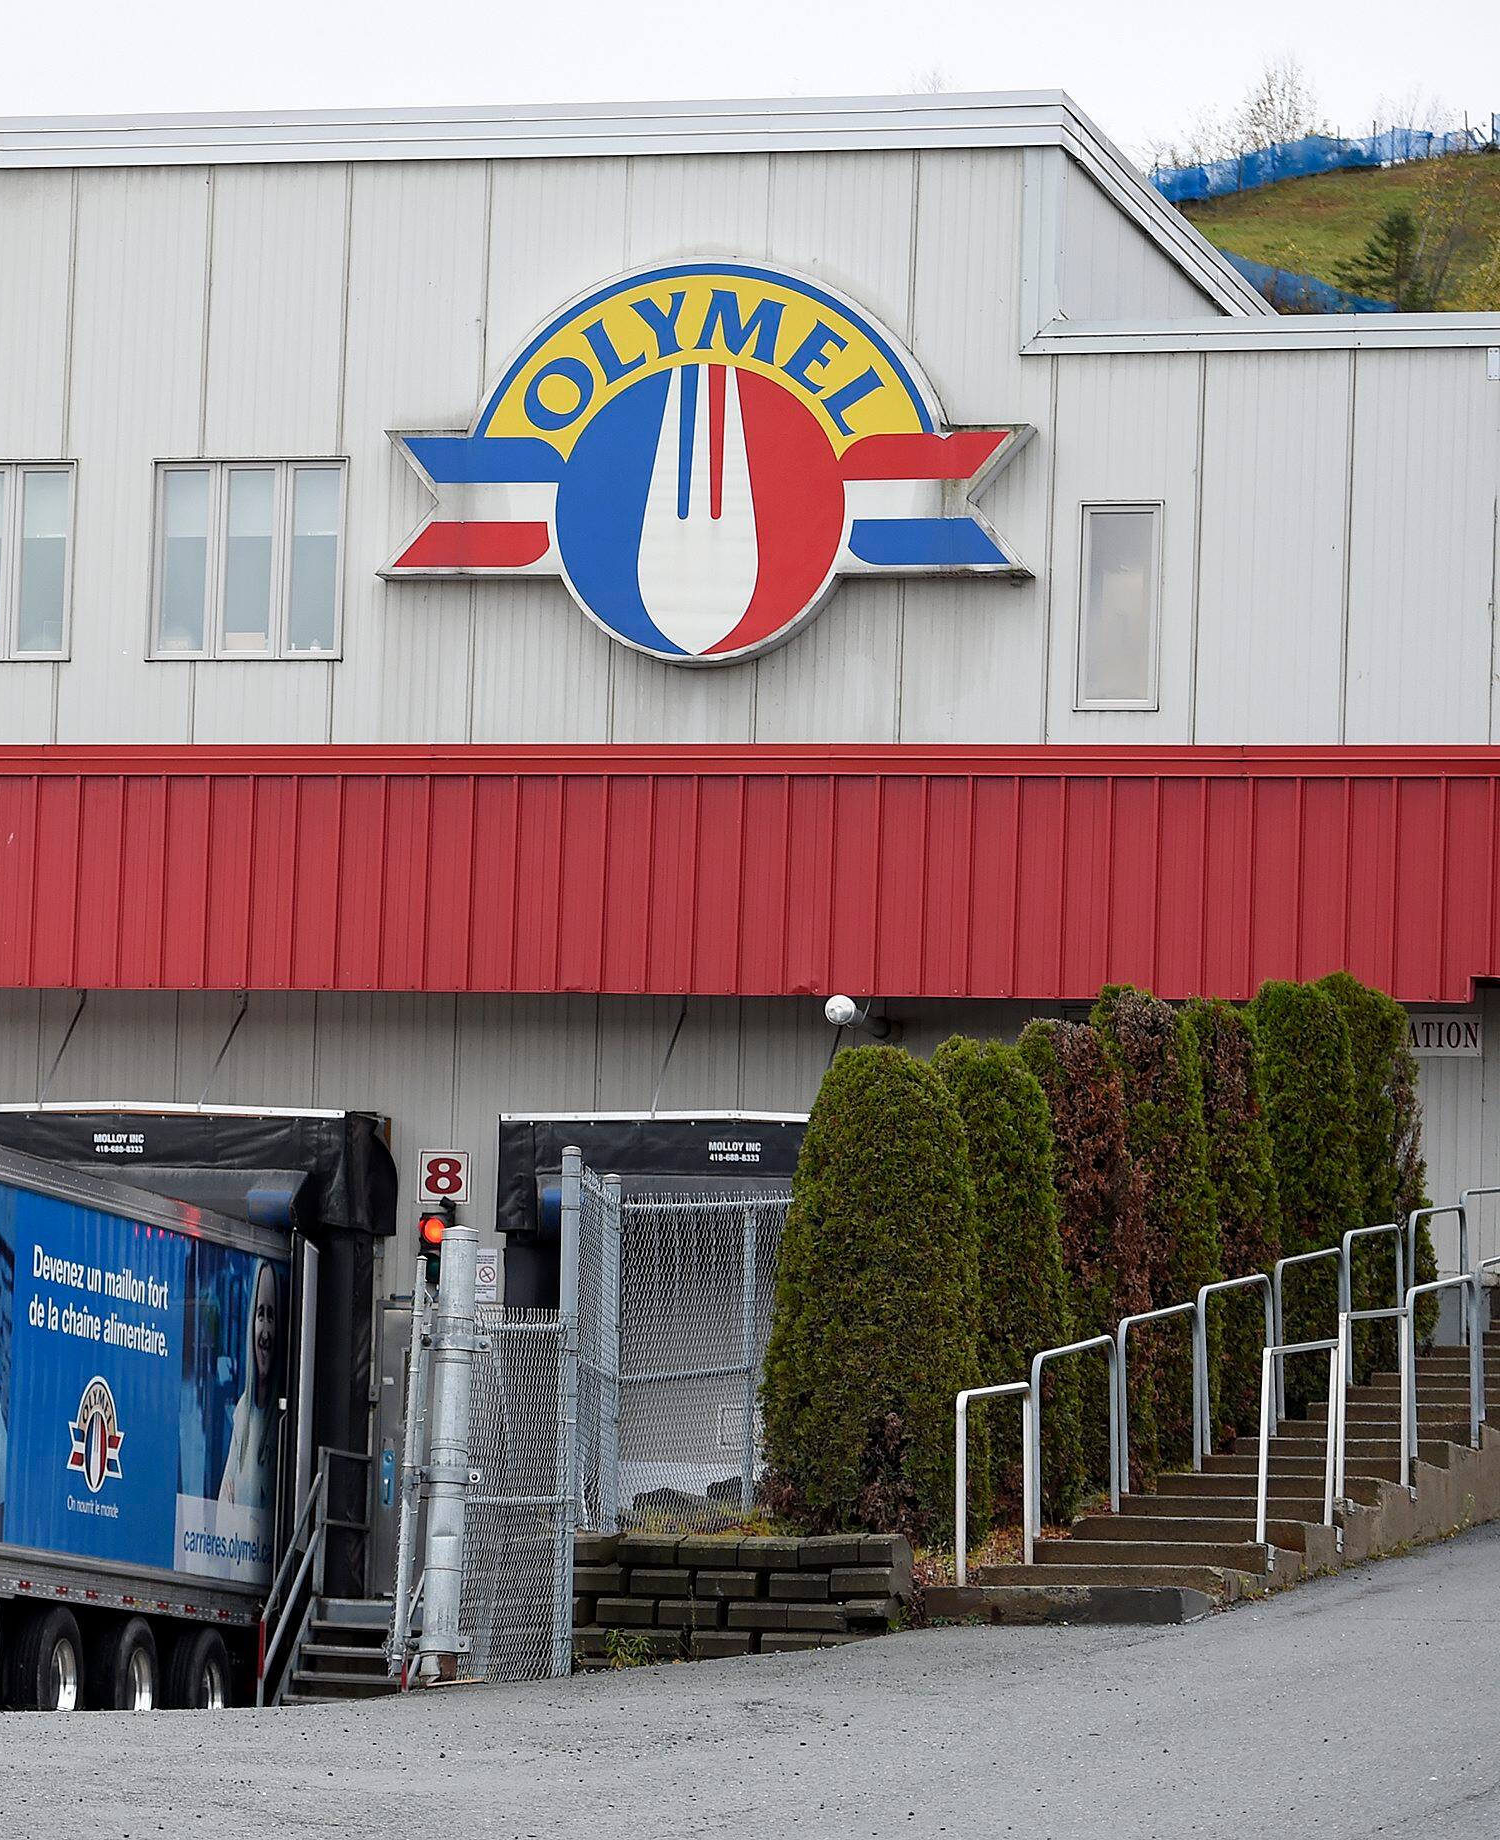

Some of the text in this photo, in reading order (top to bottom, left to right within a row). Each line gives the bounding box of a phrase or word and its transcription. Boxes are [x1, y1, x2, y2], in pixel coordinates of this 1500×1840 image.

[524, 289, 886, 437] OLYMEL
[1407, 1021, 1480, 1048] ATION
[93, 1133, 145, 1144] MOLLOY INC
[708, 1141, 762, 1152] MOLLOY INC
[425, 1157, 463, 1195] 8
[33, 1245, 169, 1311] Devenez un maillon fort
[28, 1293, 169, 1357] de la chaîne alimentaire.
[82, 1389, 112, 1425] OLYMEL
[67, 1495, 76, 1511] On
[94, 1500, 101, 1515] le
[100, 1503, 119, 1518] monde
